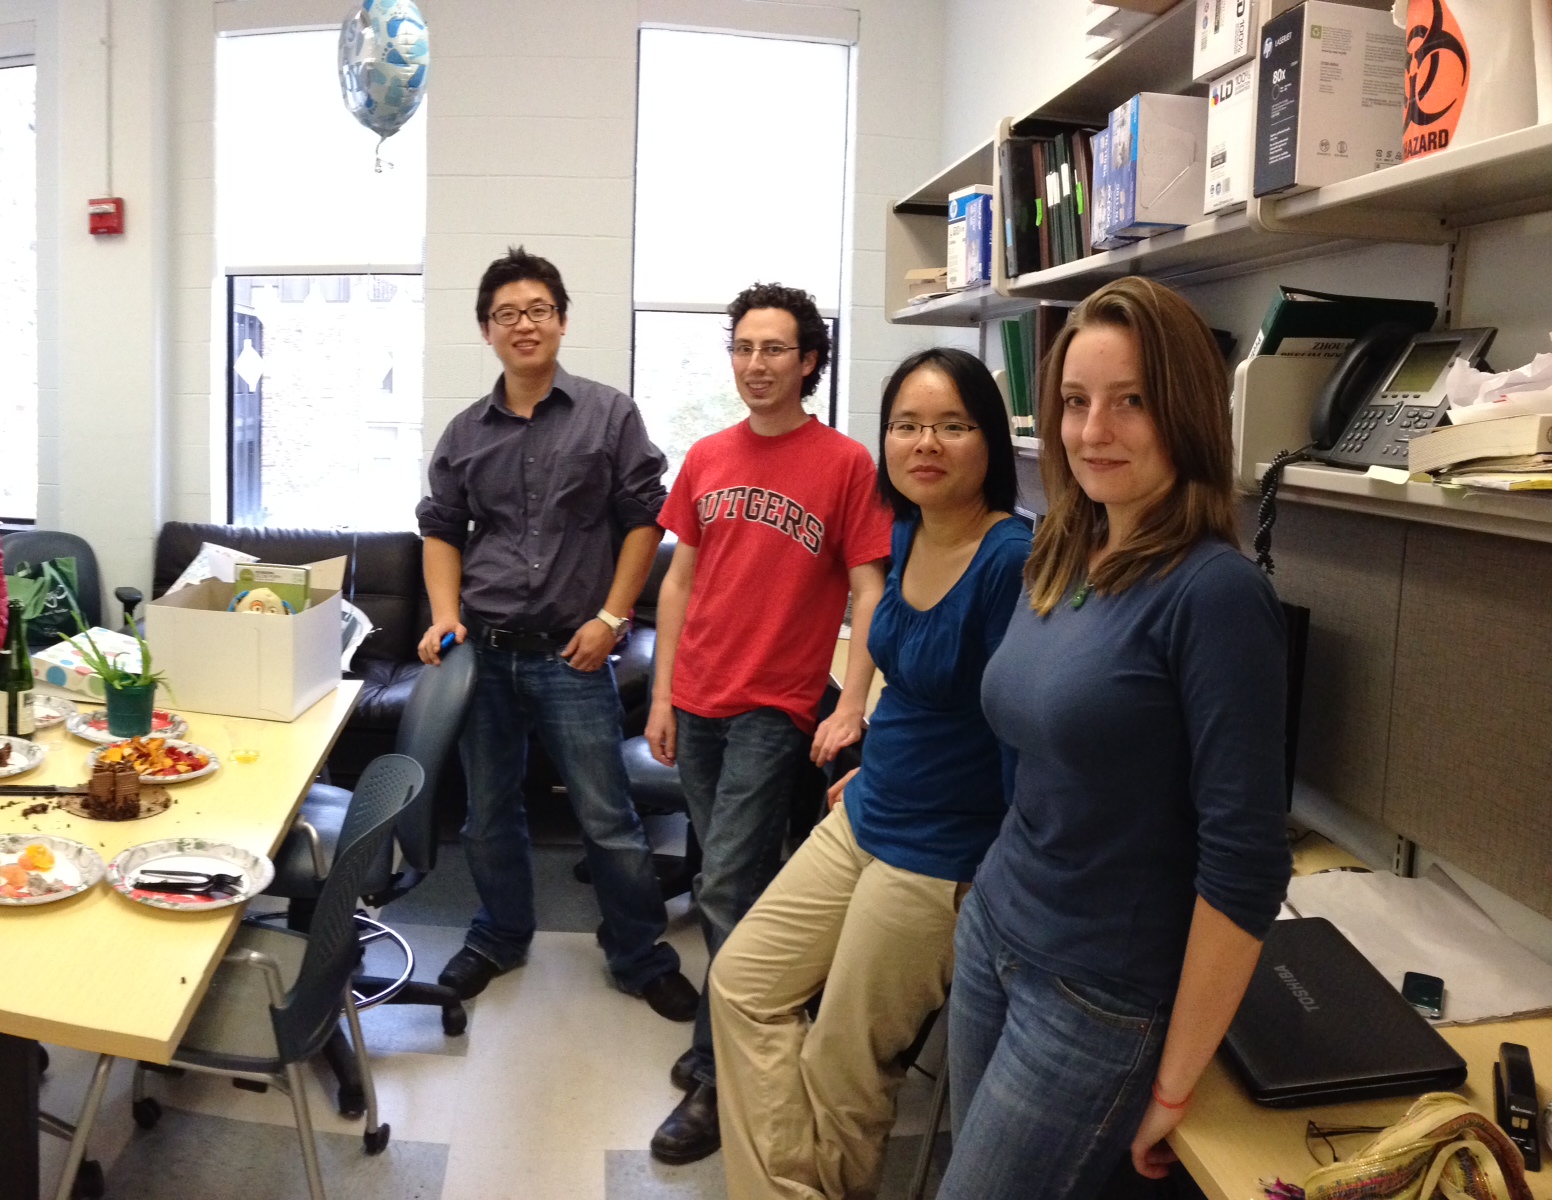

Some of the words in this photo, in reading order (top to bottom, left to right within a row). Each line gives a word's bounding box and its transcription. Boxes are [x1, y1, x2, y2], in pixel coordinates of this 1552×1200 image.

[1219, 79, 1234, 103] LD
[698, 486, 825, 555] UTGERS
[1273, 964, 1321, 1013] TOSHIBA
